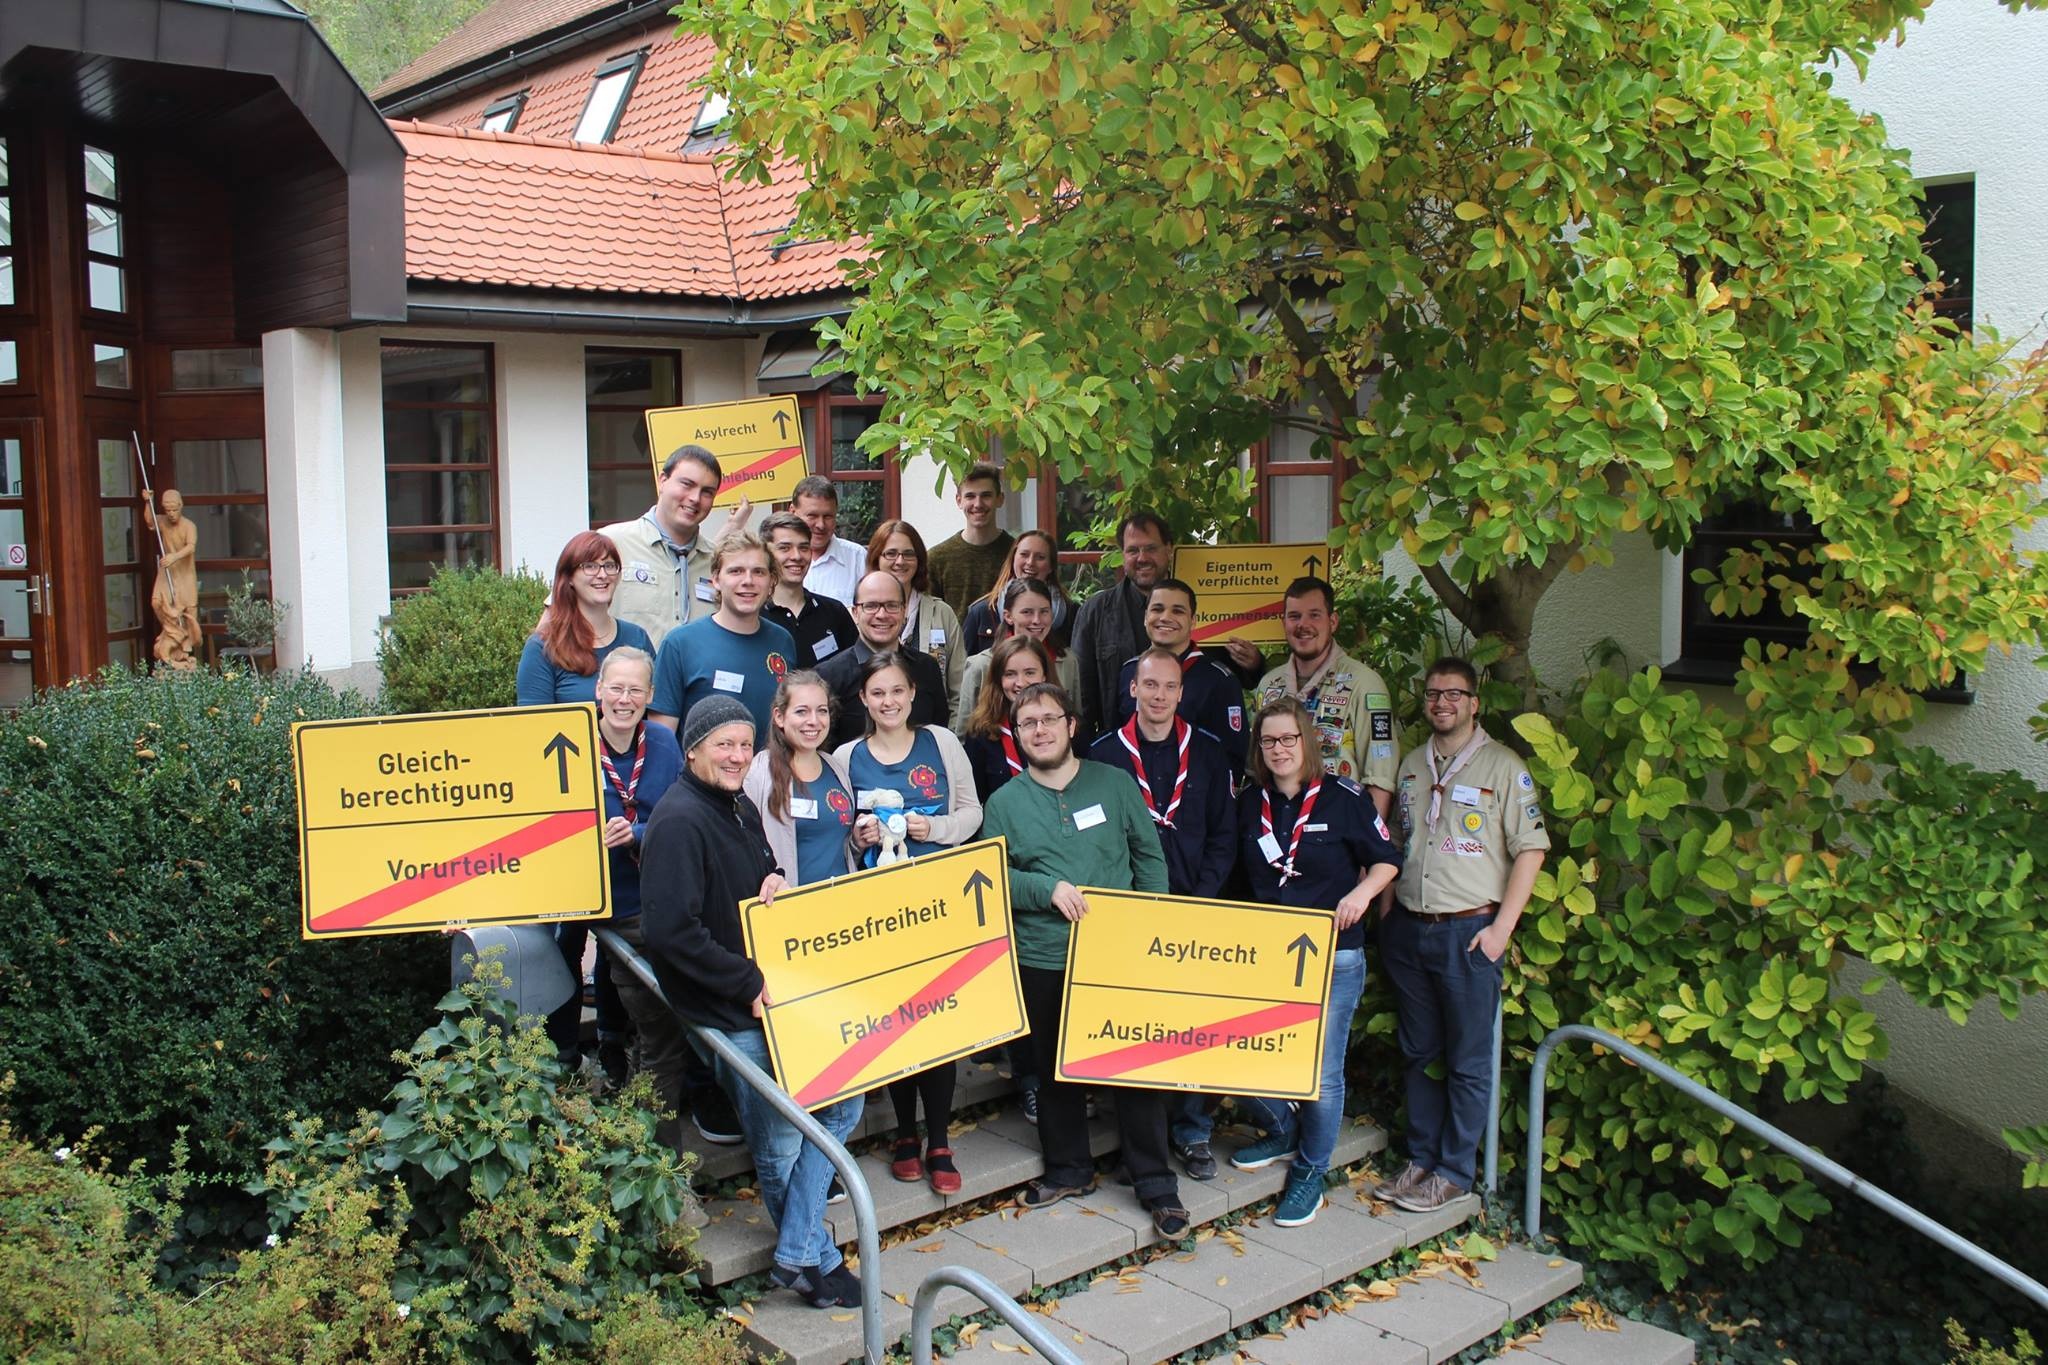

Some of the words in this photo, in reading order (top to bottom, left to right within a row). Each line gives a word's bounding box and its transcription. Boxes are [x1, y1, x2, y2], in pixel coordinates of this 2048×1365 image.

[694, 423, 757, 441] Asylrecht
[722, 469, 776, 484] hiebung
[1197, 574, 1280, 589] verpflichtet
[1206, 561, 1273, 574] Eigentum
[1195, 611, 1285, 622] nkommenssc
[378, 749, 471, 776] Gleich-
[341, 780, 514, 809] berechtigung
[387, 852, 522, 881] Vorurteile
[784, 898, 948, 961] Pressefreiheit
[1147, 936, 1257, 965] Asylrecht
[840, 1013, 892, 1045] Fake
[898, 991, 959, 1026] News
[1087, 1019, 1220, 1048] „Ausländer
[1226, 1032, 1297, 1053] raus!“
